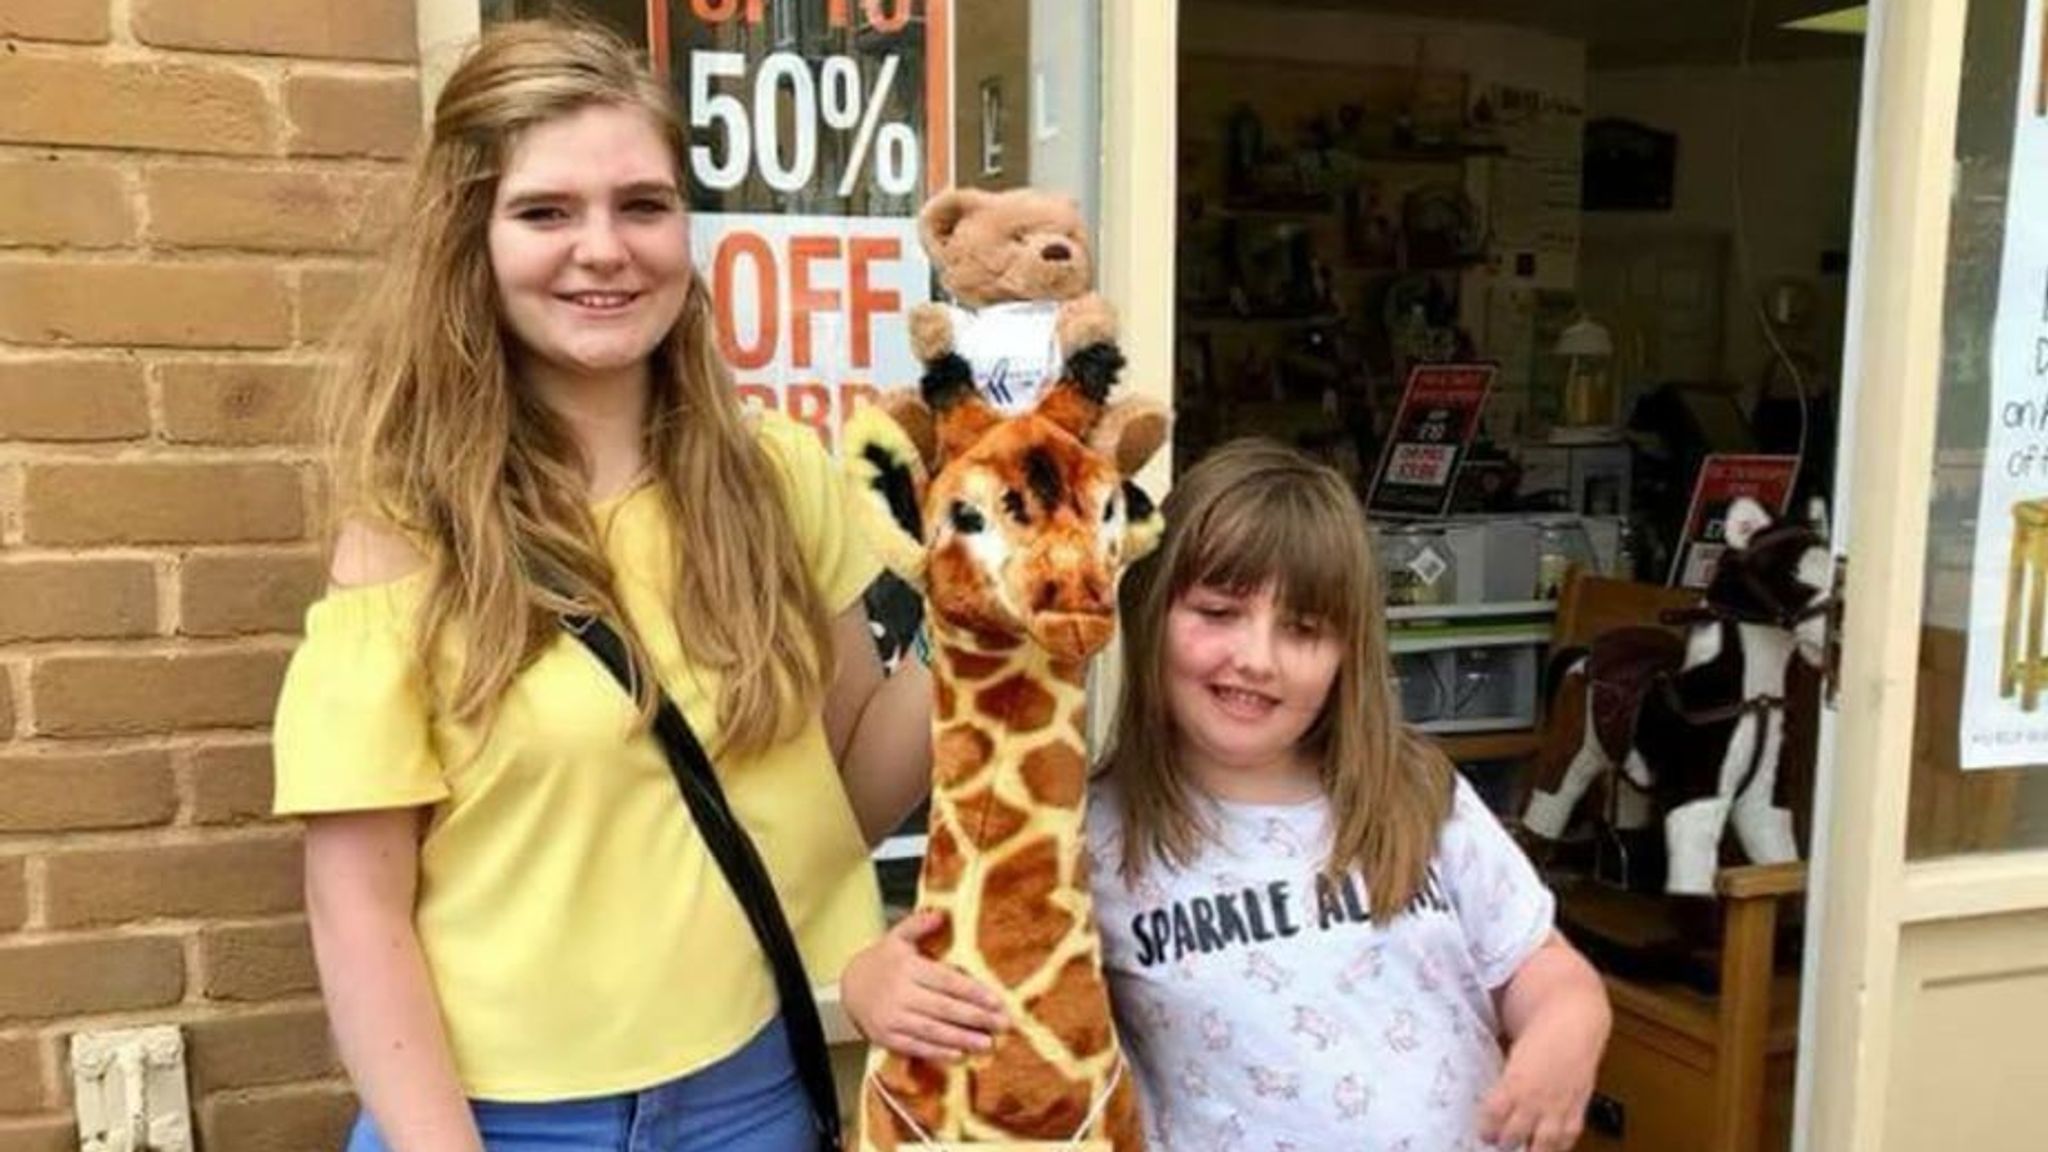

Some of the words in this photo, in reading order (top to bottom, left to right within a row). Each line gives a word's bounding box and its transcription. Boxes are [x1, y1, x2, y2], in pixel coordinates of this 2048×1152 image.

[690, 50, 917, 196] 50%
[713, 230, 901, 371] OFF
[1131, 880, 1300, 967] SPARKLE
